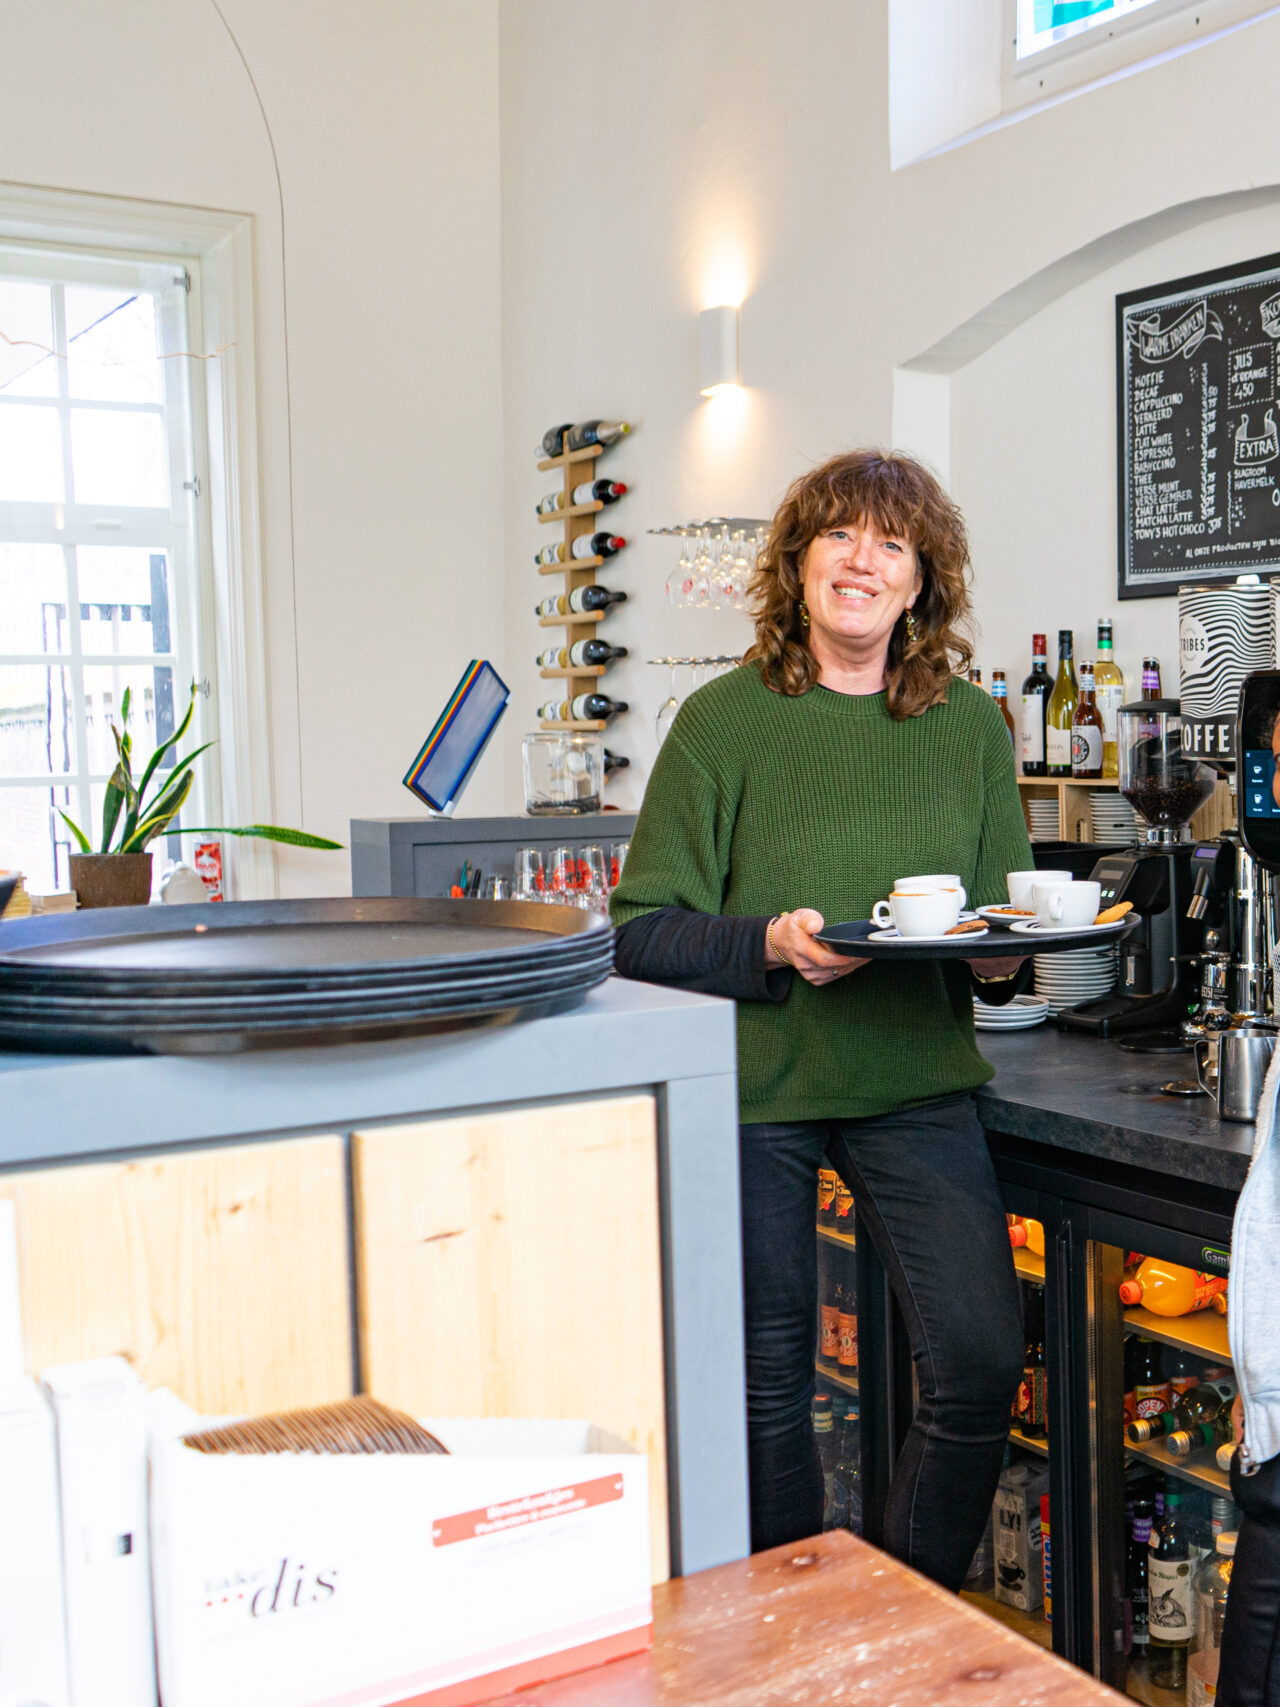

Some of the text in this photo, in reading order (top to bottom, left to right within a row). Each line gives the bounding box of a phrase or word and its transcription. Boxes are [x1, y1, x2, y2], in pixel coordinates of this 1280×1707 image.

[1170, 309, 1205, 352] DRANKEN
[1233, 351, 1254, 371] JUS
[1134, 370, 1164, 388] KOFFIE
[1133, 385, 1159, 401] DECAF
[1133, 392, 1183, 413] CAPPUCCINO
[1133, 407, 1173, 425] VERKEERD
[1135, 421, 1158, 437] LATTE
[1134, 436, 1150, 449] FLAT
[1150, 432, 1173, 446] WHITE
[1239, 438, 1275, 459] EXTRA
[1134, 446, 1174, 461] ESPRESSO
[1133, 457, 1176, 475] BABYCCINO
[1133, 473, 1153, 486] THEE
[1135, 483, 1157, 497] VERSE
[1158, 480, 1180, 493] MUNT
[1234, 476, 1275, 490] HAVERMELK
[1135, 494, 1158, 507] VERSE
[1159, 488, 1192, 503] GEMBER
[1156, 502, 1178, 515] LATTE
[1136, 515, 1168, 529] MATCHA
[1168, 511, 1193, 524] LATTE
[1162, 524, 1178, 538] HOT
[1179, 523, 1205, 536] CHOCO
[1181, 723, 1237, 753] OFFE
